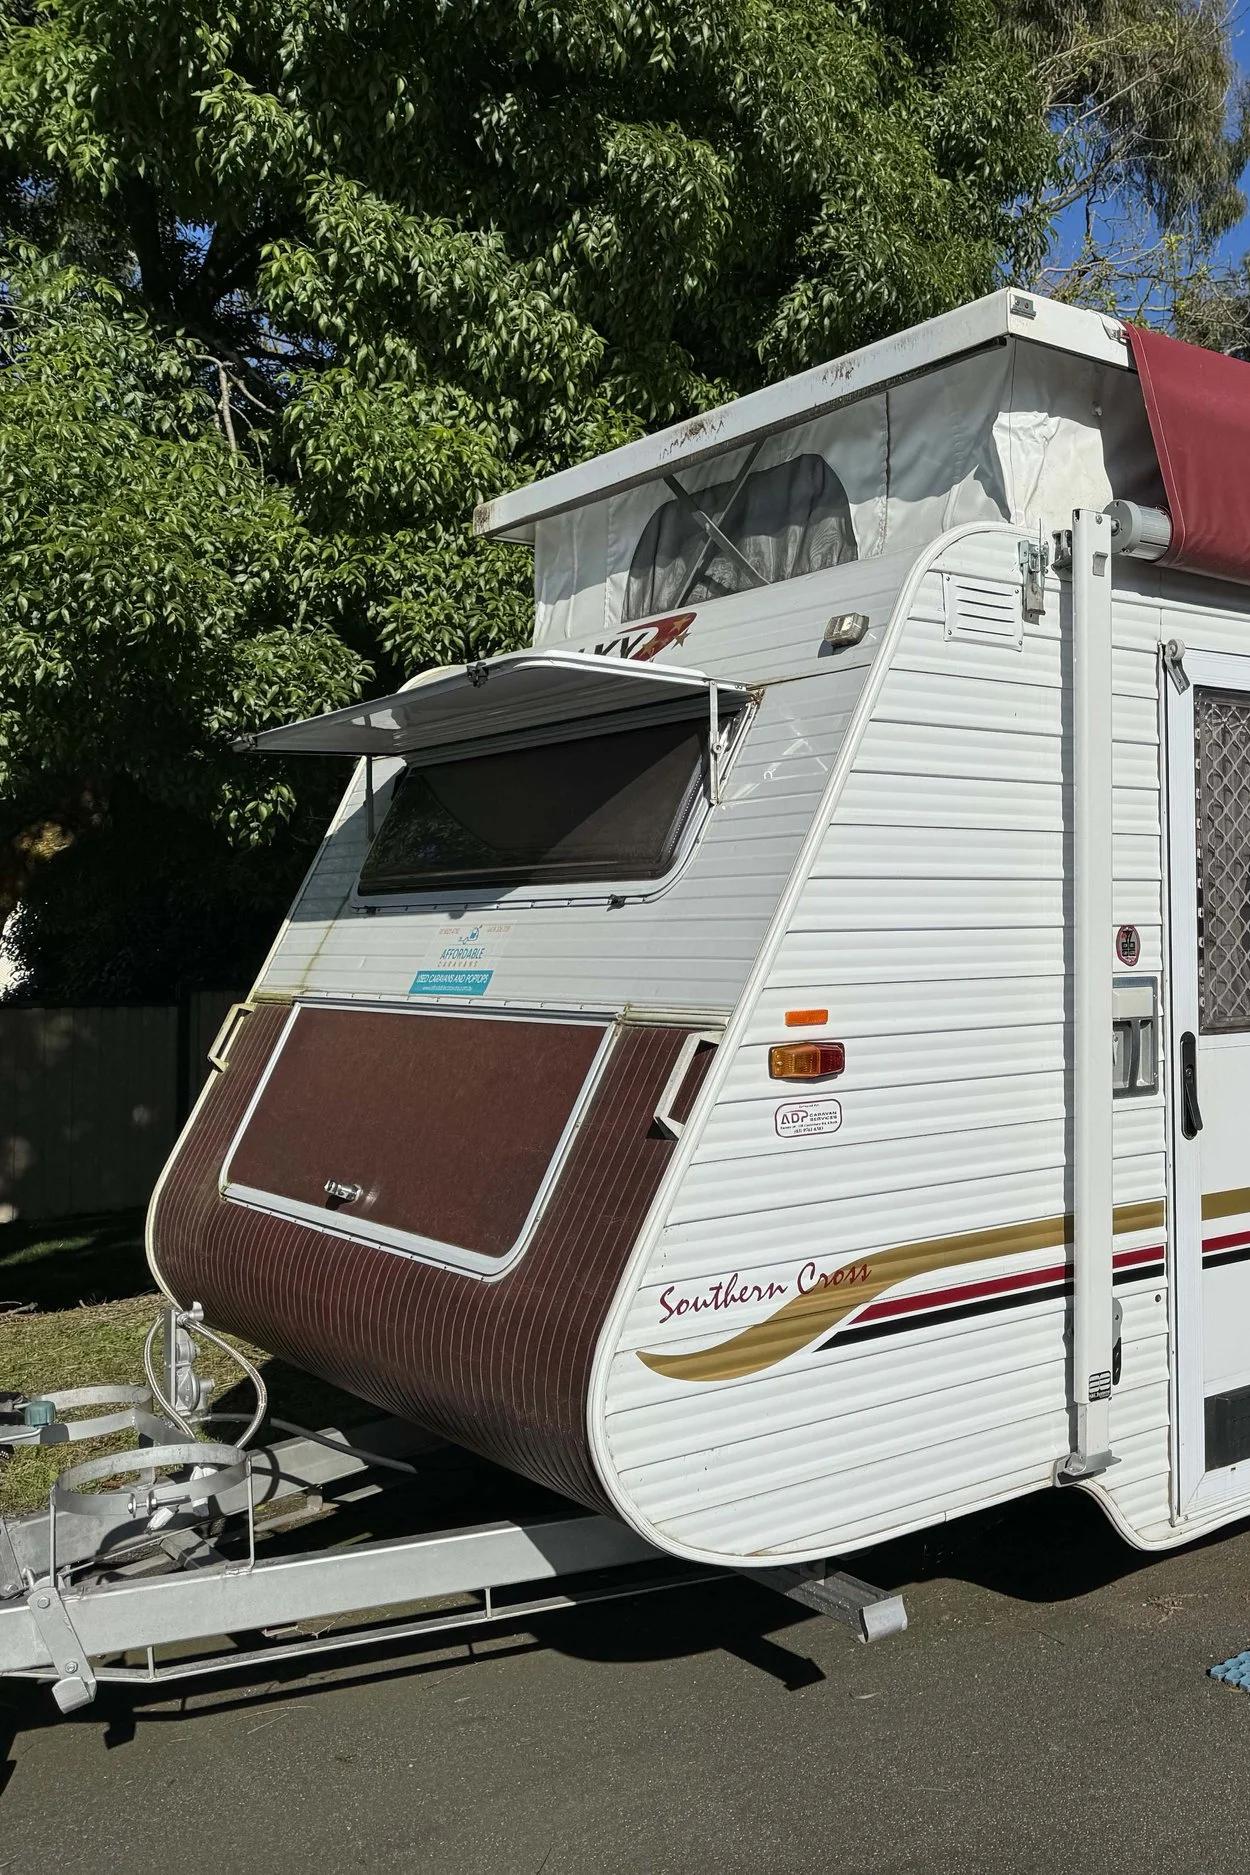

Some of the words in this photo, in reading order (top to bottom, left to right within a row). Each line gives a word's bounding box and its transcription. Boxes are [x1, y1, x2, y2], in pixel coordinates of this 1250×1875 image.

[440, 948, 485, 959] AFFORDABLE
[437, 960, 479, 968] CARAVANS
[429, 974, 455, 983] CARAVANS
[454, 974, 466, 983] AND
[781, 1110, 808, 1124] ADP
[658, 1272, 788, 1325] Southern
[796, 1260, 873, 1296] Cross
